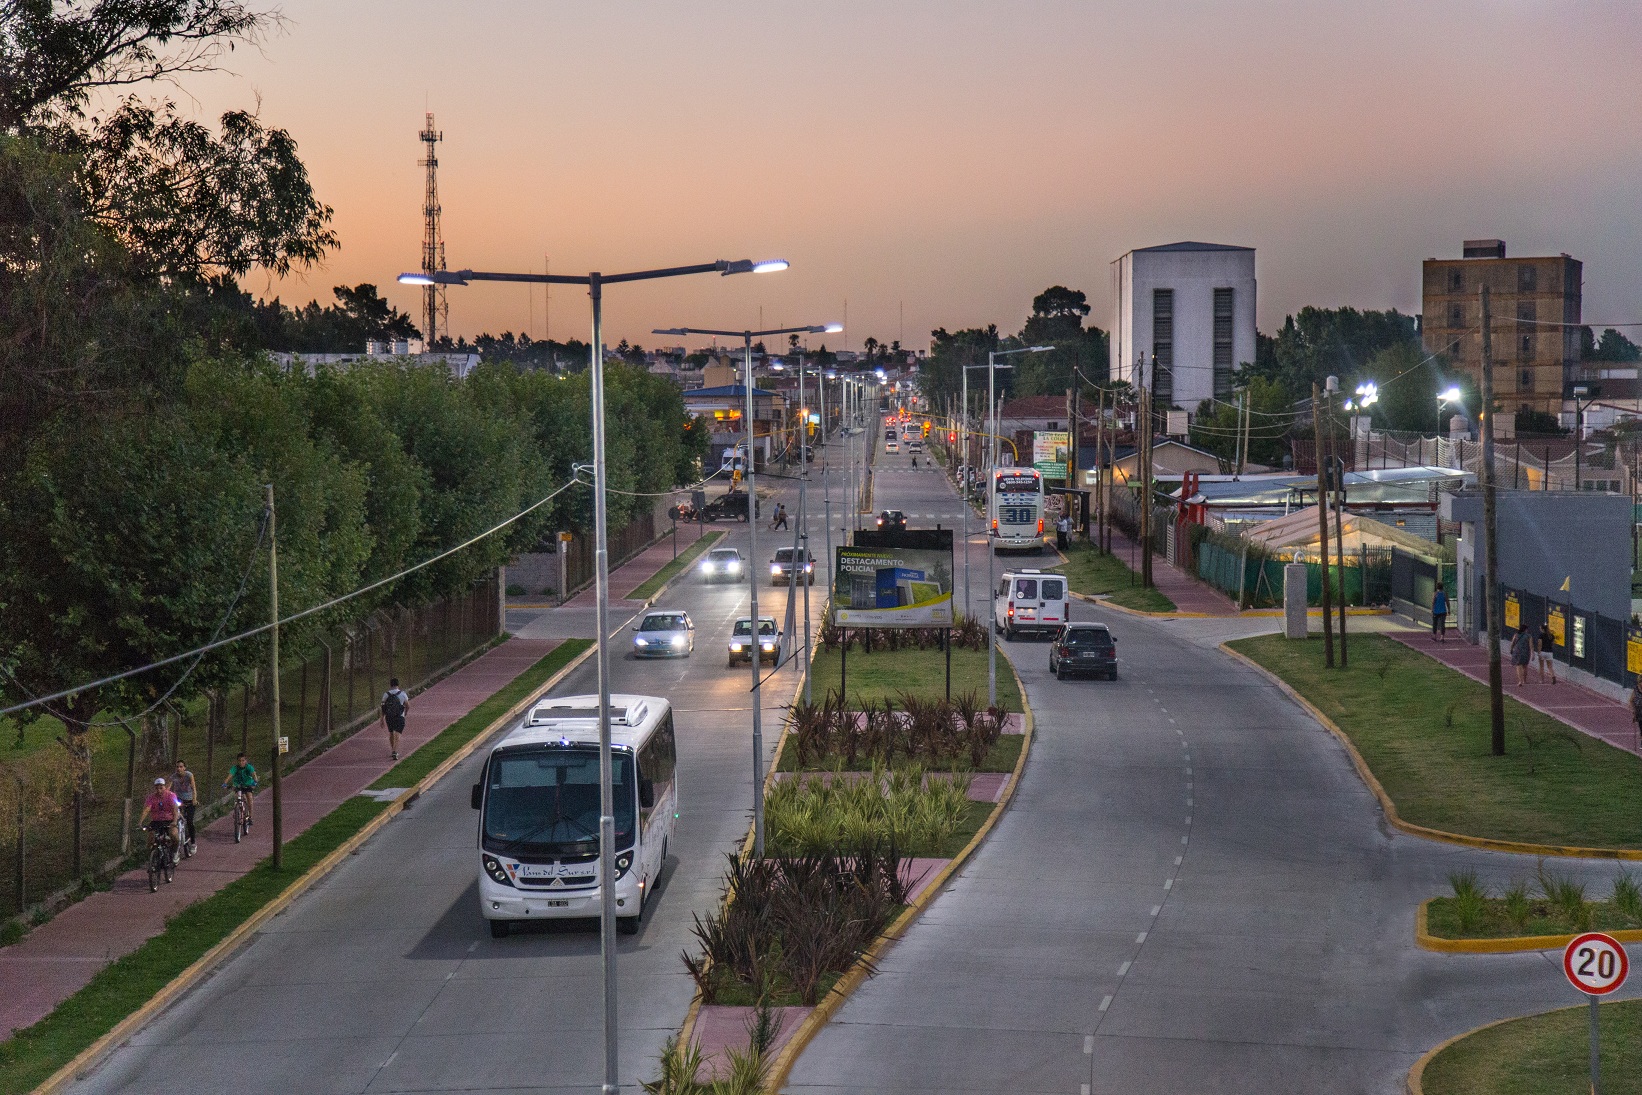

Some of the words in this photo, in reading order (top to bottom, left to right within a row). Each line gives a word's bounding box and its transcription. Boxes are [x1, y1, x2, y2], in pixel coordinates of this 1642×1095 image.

[1005, 508, 1031, 522] 30
[841, 557, 904, 566] DESTACAMENTO
[841, 565, 876, 573] POLICIAL
[543, 866, 553, 876] del
[556, 865, 578, 876] Sur
[1578, 947, 1616, 979] 20
